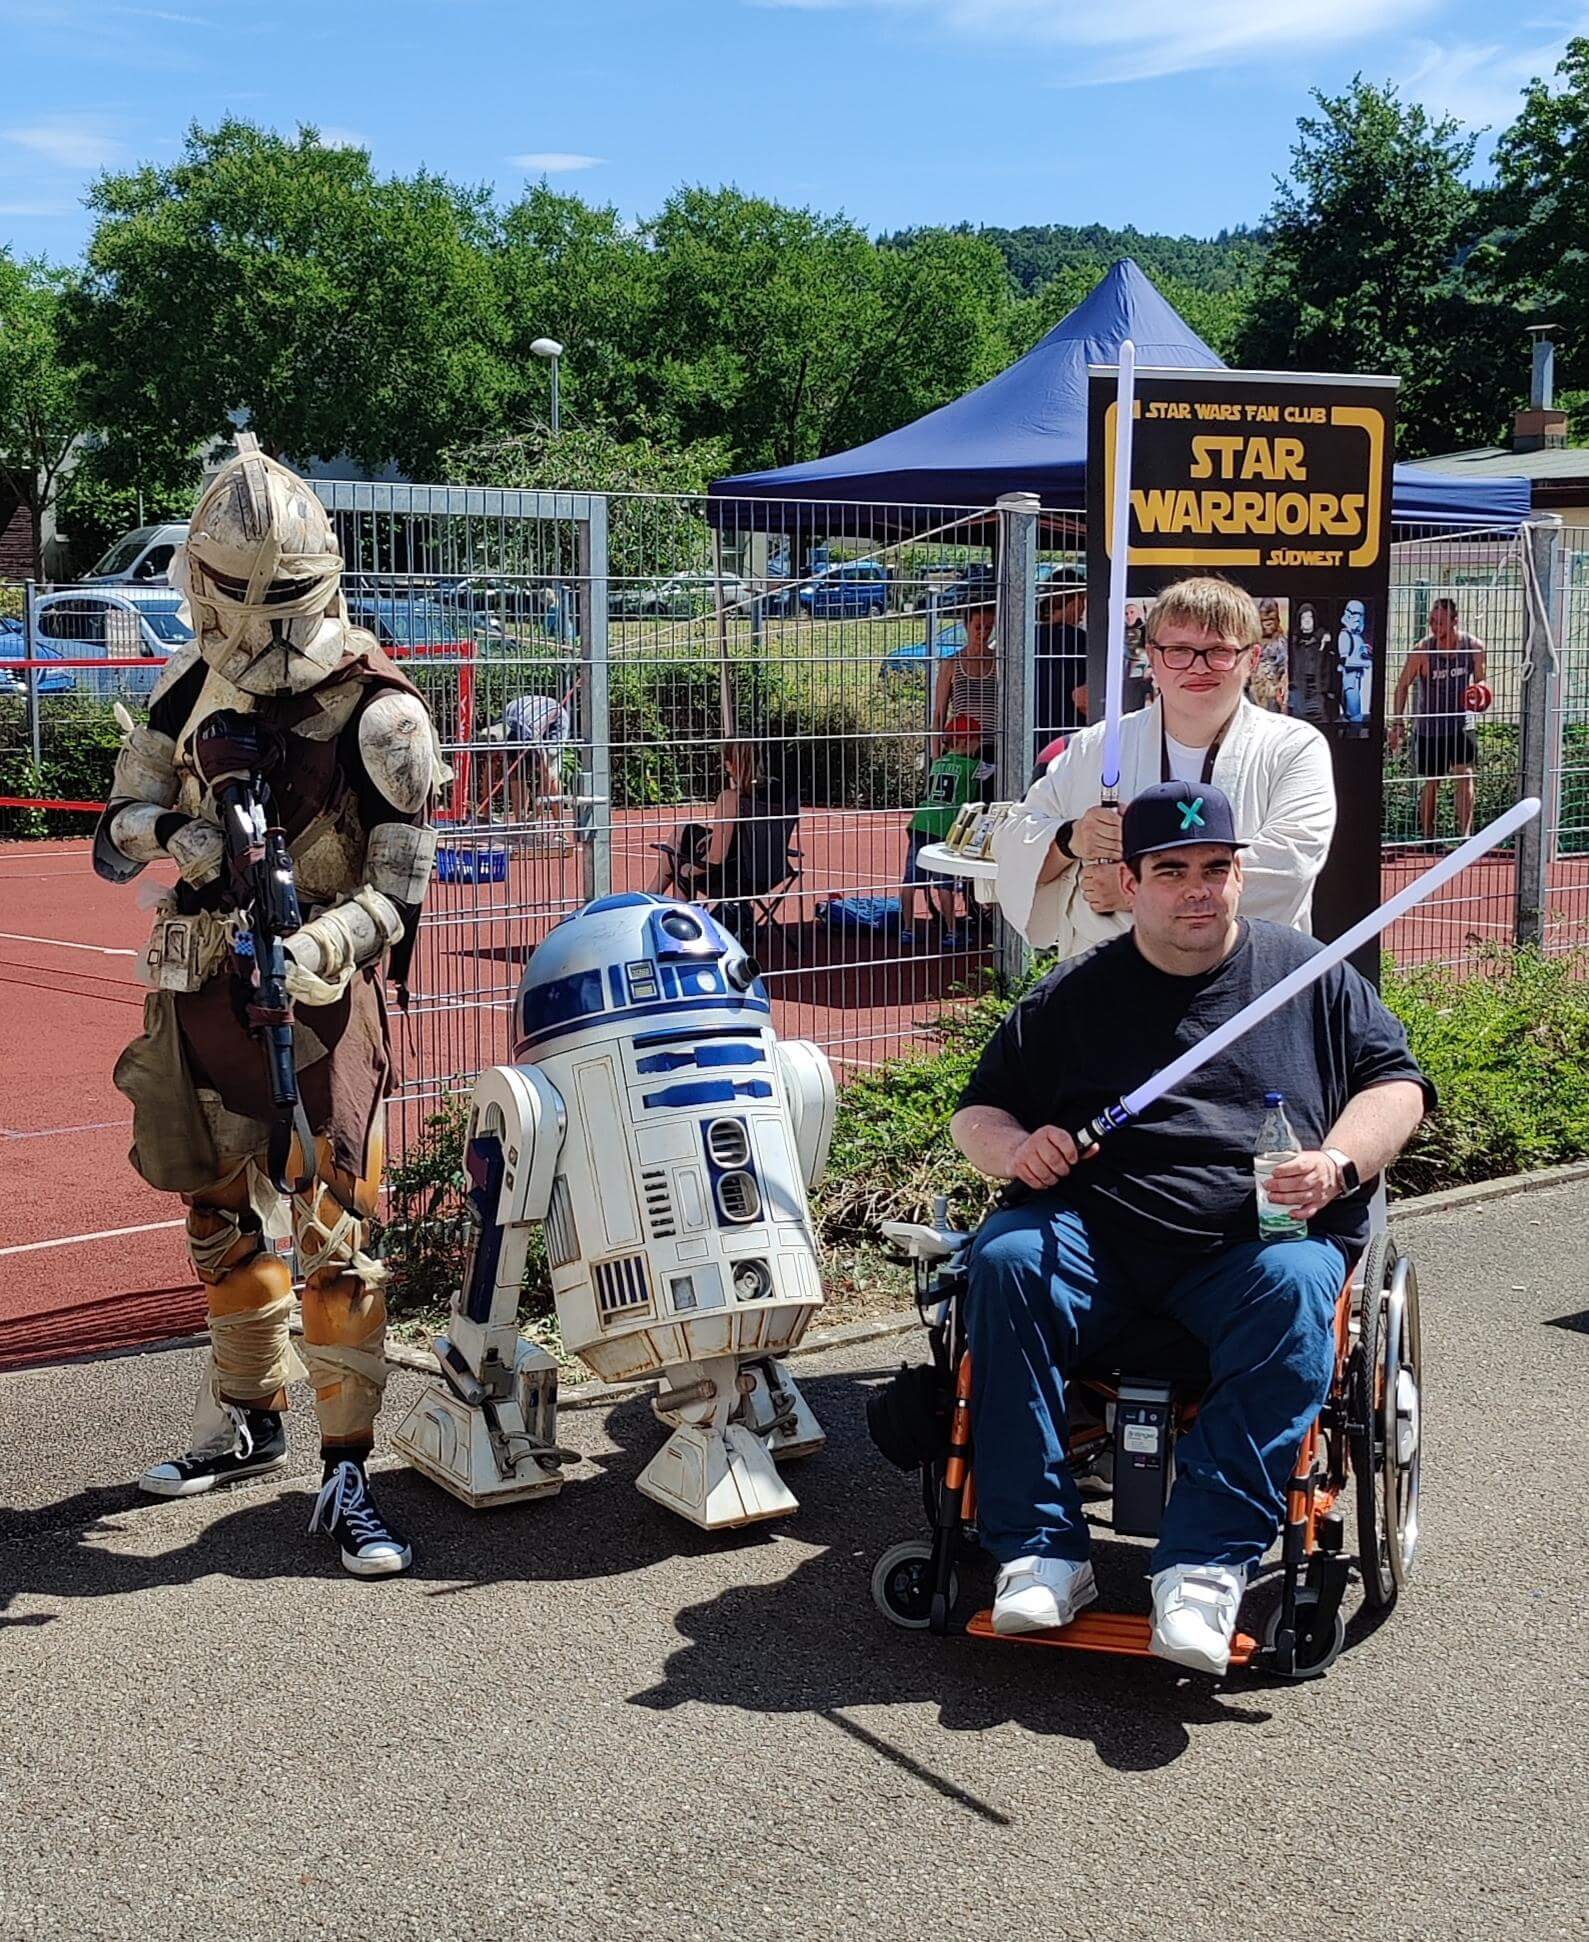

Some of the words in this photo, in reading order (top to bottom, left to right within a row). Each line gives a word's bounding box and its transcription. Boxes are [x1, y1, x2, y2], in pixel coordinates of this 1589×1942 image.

[1145, 402, 1192, 420] STAR
[1194, 403, 1241, 421] WARS
[1244, 404, 1280, 422] FAN
[1284, 406, 1327, 424] CLUB
[1190, 435, 1307, 481] STAR
[1129, 489, 1365, 536] WARRIORS
[1265, 547, 1344, 566] SÜDWEST
